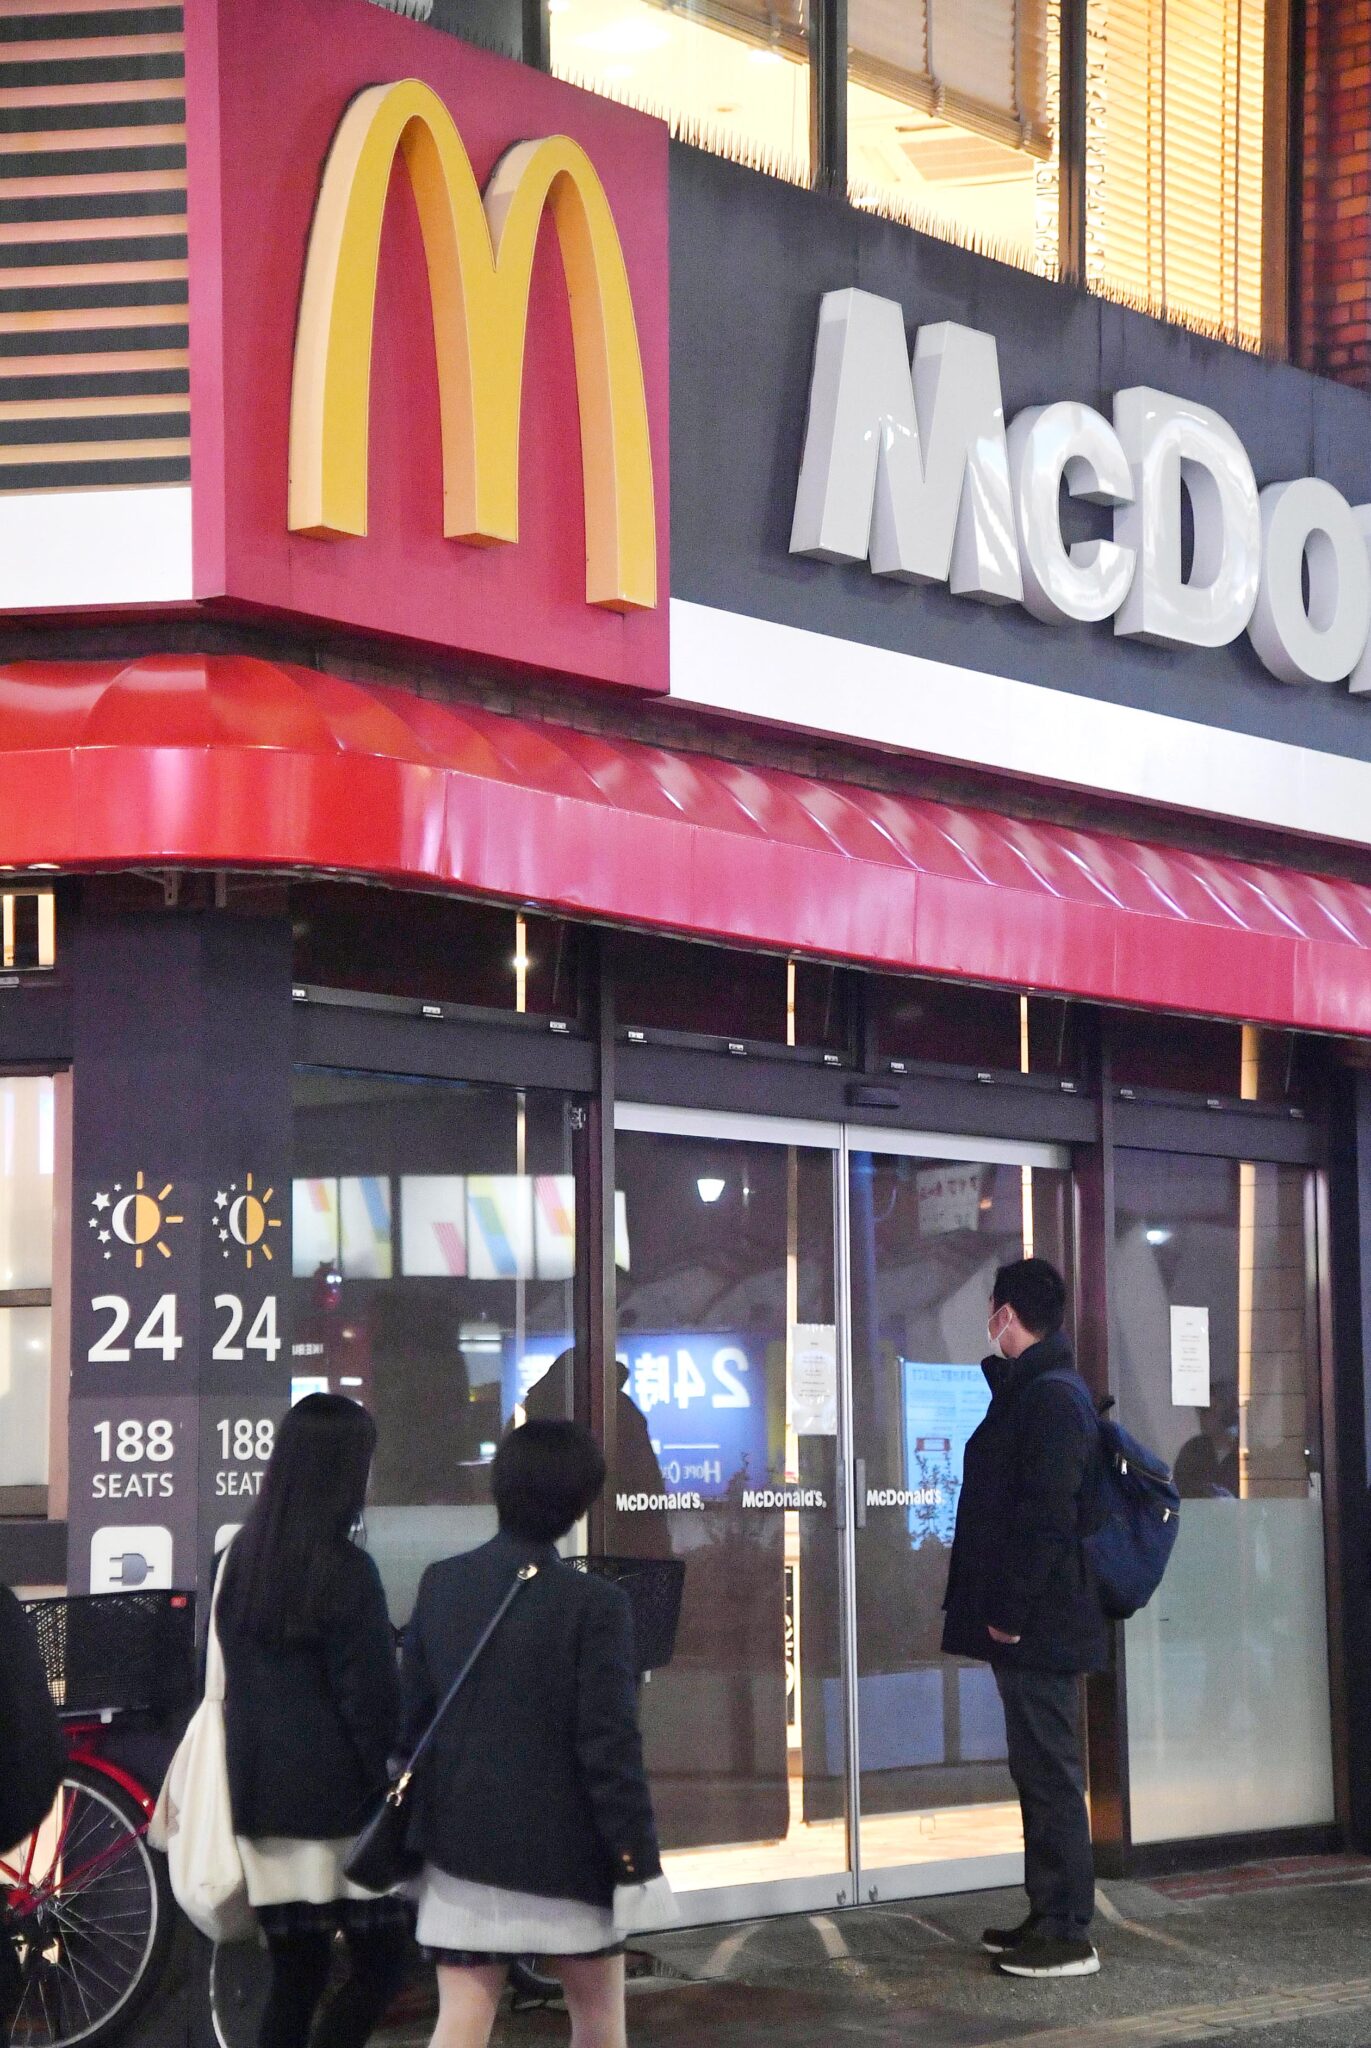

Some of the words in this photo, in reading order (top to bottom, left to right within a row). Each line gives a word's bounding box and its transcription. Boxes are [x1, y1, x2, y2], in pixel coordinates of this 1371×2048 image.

[788, 286, 1371, 695] McDo
[88, 1294, 182, 1362] 24
[212, 1294, 281, 1362] 24
[94, 1419, 174, 1462] 188
[216, 1419, 274, 1460] 188
[92, 1472, 174, 1498] SEATS
[215, 1471, 264, 1496] SEAT
